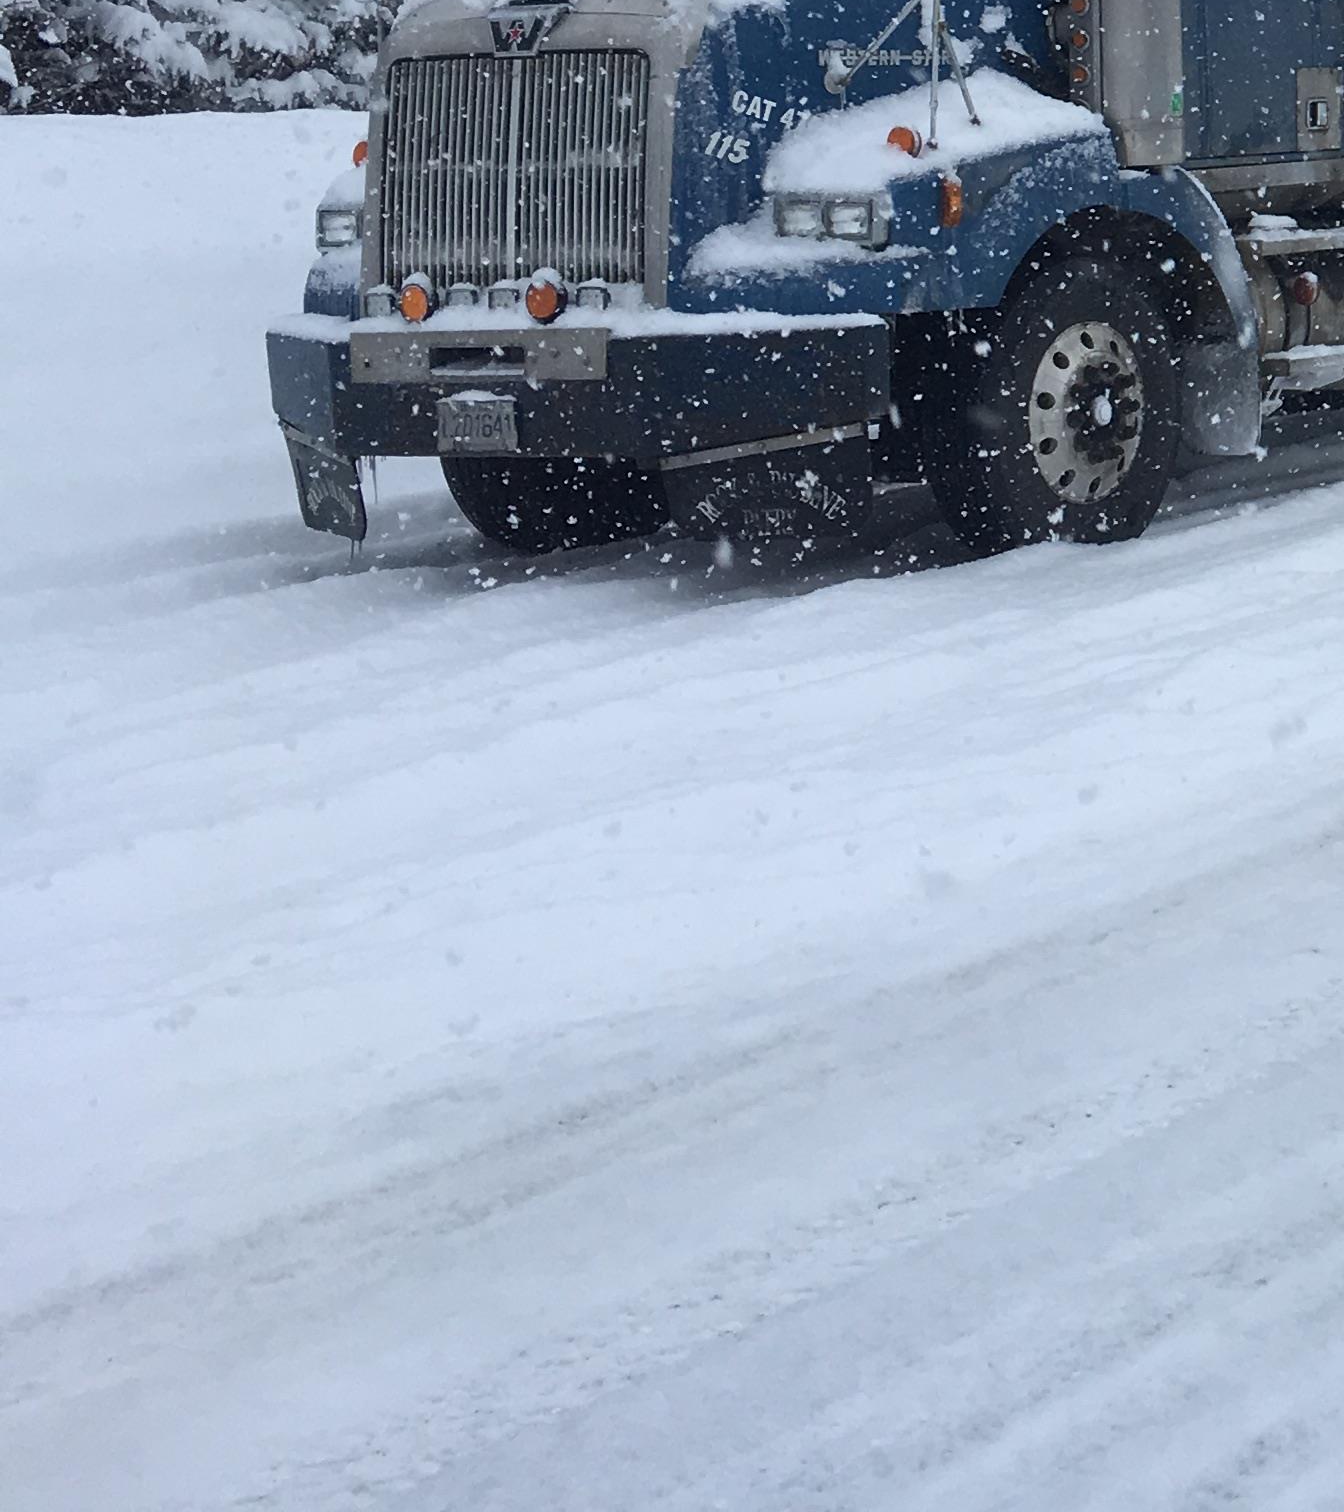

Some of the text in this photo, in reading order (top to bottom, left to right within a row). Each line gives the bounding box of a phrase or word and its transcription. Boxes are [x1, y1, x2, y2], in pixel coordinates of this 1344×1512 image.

[818, 48, 953, 67] WSERN STR
[731, 90, 776, 122] CAT
[704, 130, 751, 164] 115
